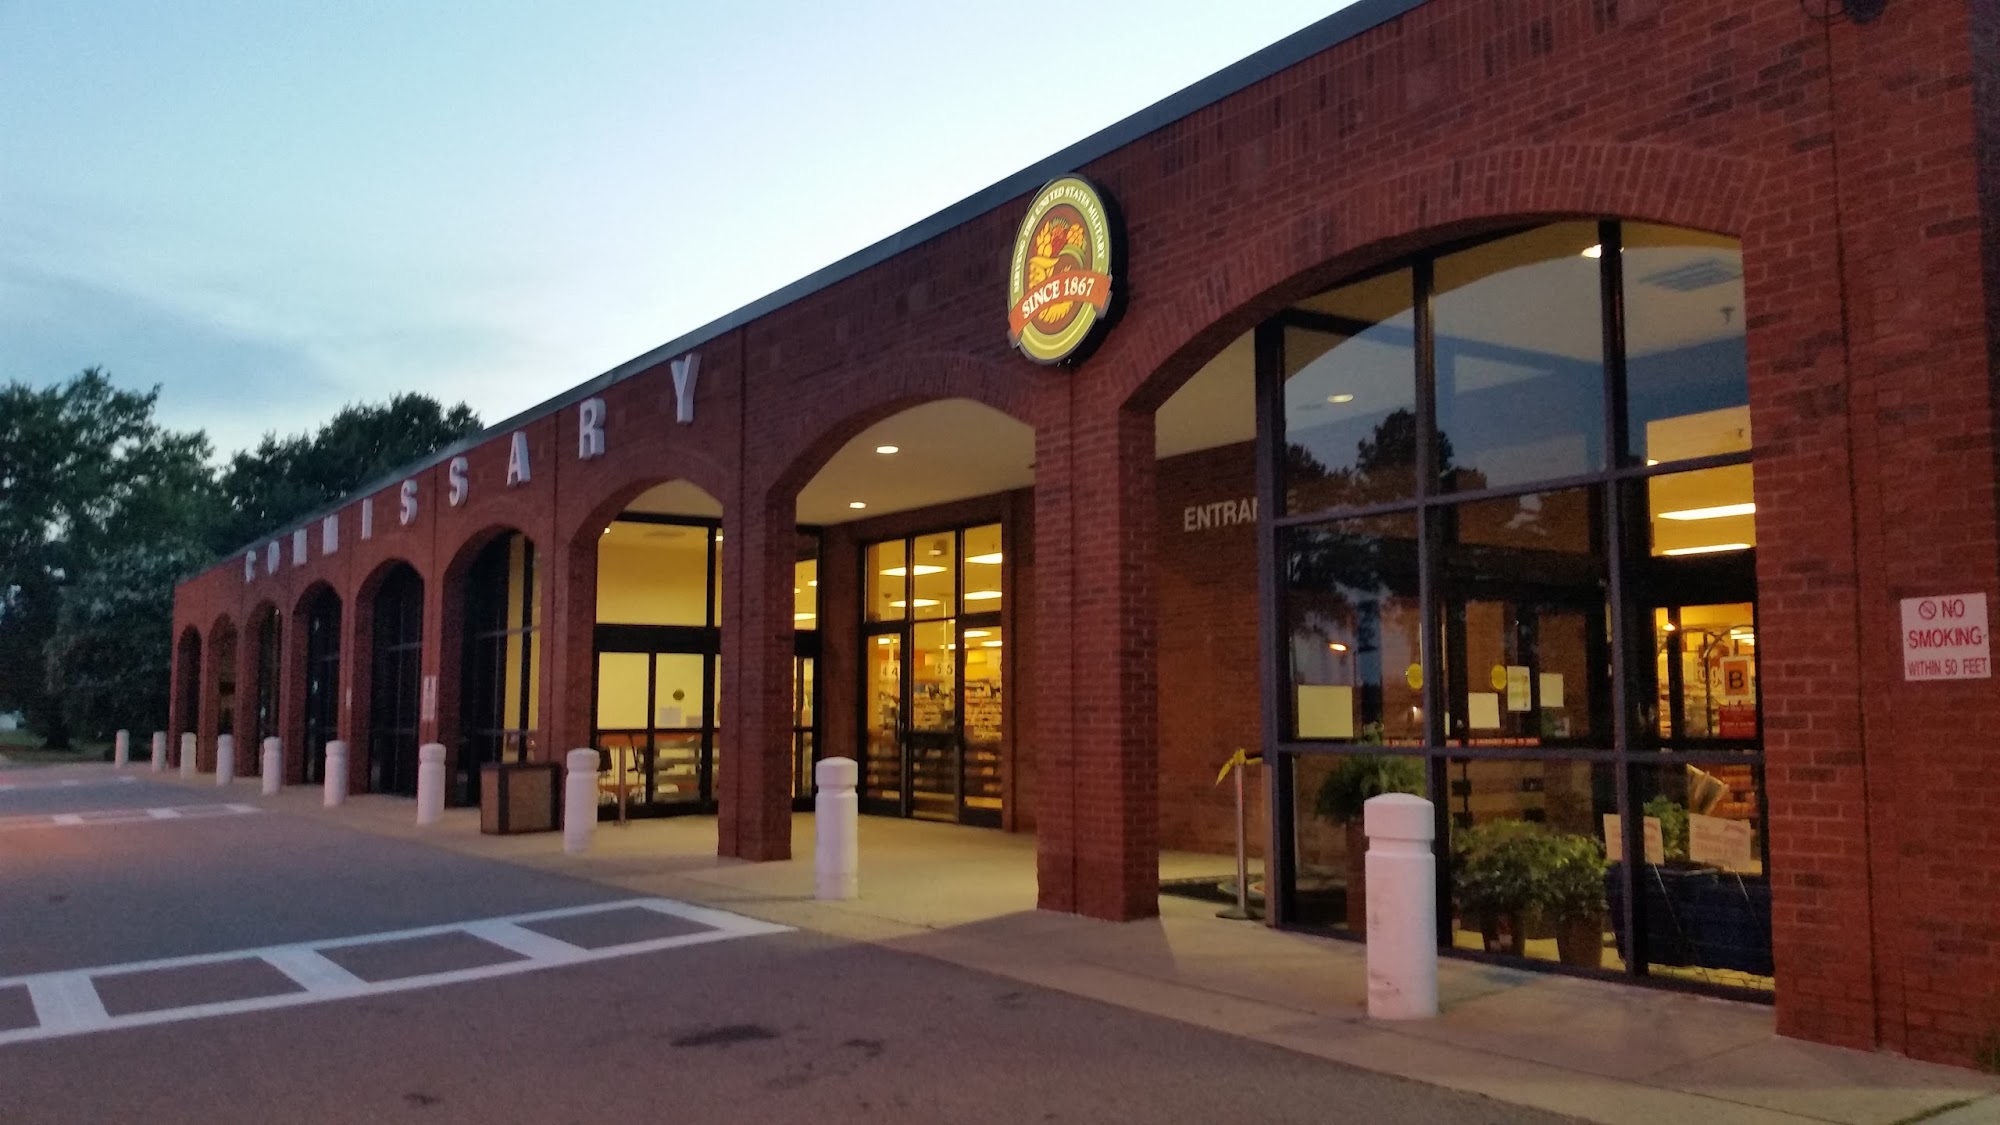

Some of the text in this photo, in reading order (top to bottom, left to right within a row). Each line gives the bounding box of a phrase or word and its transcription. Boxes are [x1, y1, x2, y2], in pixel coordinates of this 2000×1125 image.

[1034, 186, 1065, 216] UNITED
[1065, 186, 1092, 207] STATES
[1087, 203, 1105, 259] MILITARY
[1022, 276, 1095, 319] SINCE 1867
[1941, 599, 1966, 618] NO
[1908, 625, 1982, 649] SMOKING
[1908, 657, 1987, 676] WITHIN 50 FEET
